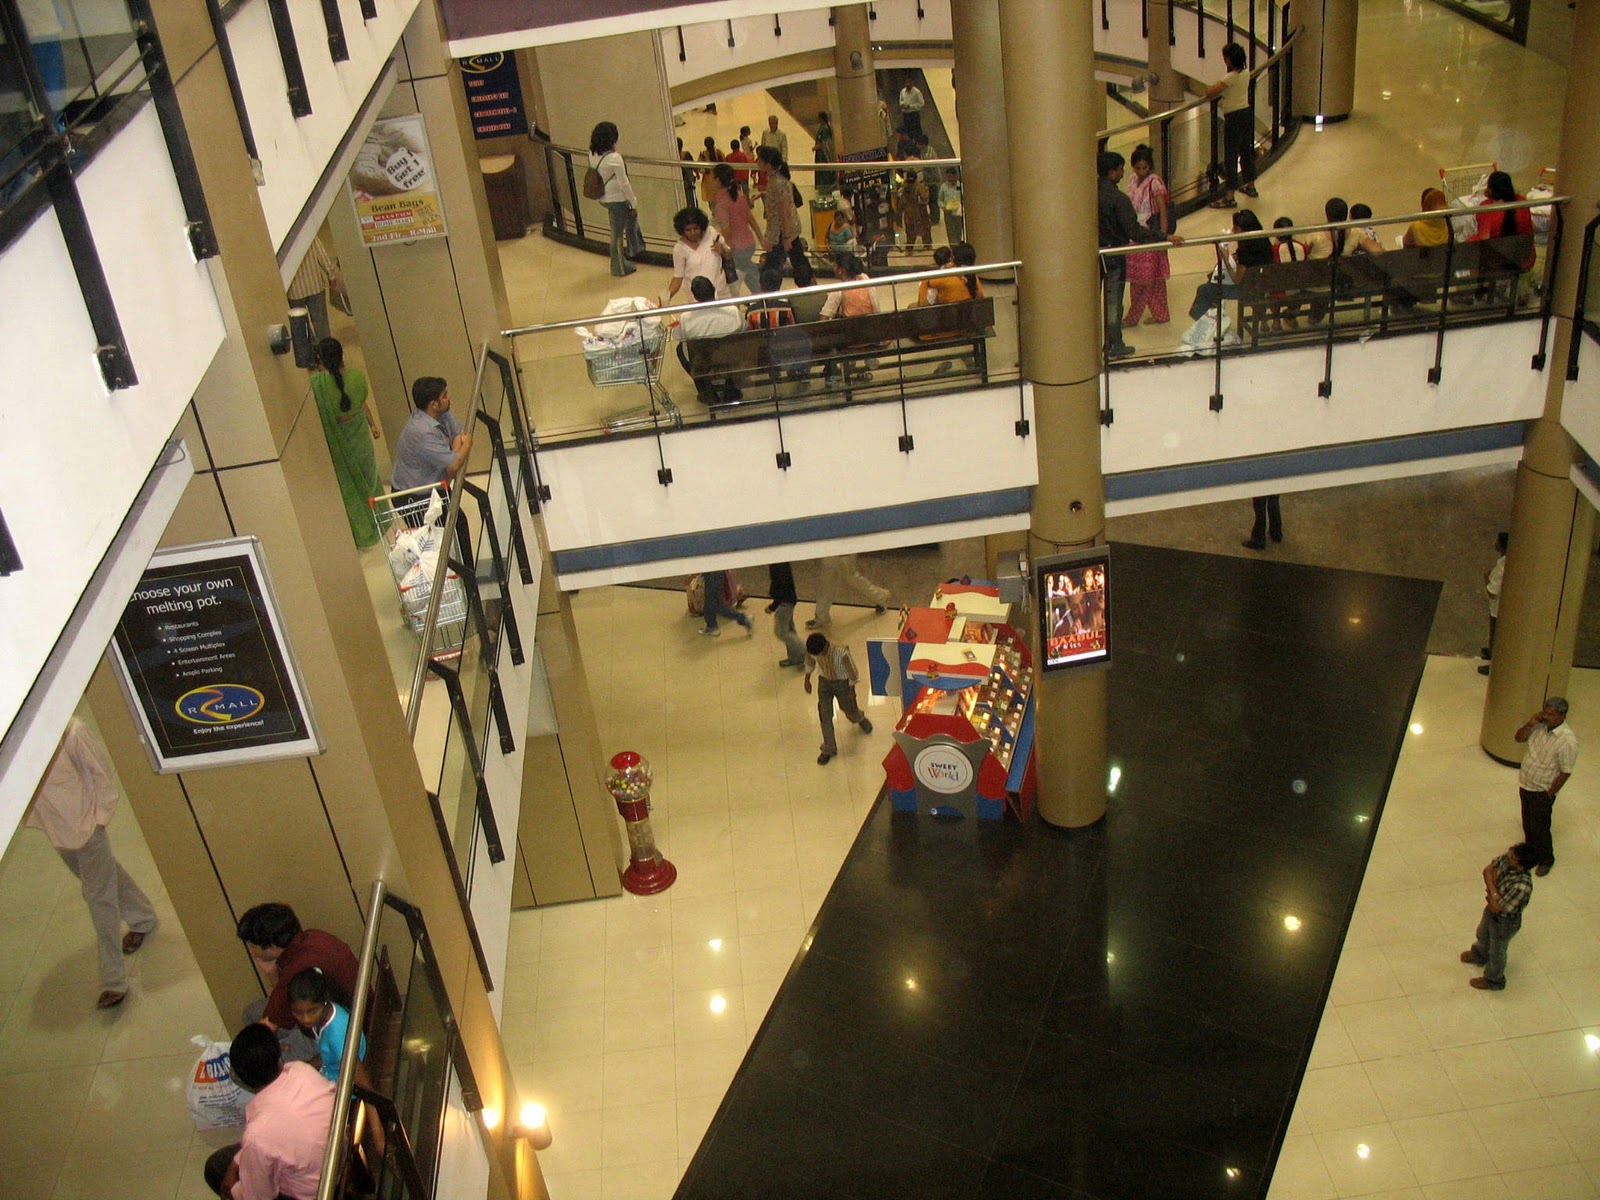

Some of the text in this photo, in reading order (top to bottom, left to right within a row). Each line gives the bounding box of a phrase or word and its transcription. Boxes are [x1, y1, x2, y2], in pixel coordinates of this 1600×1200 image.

[387, 149, 413, 175] Buy 1
[395, 166, 413, 182] Get
[372, 200, 424, 212] Bean Bags
[130, 577, 234, 602] hoose your own
[146, 594, 222, 615] melting pot.
[164, 621, 200, 630] Restaurants
[168, 629, 222, 643] Shopping Complex
[199, 641, 226, 651] Multiplex
[177, 652, 236, 666] Entertainment Areas
[200, 665, 224, 674] Parking
[187, 699, 258, 715] R MALL
[192, 719, 265, 736] Enjoy the experience!
[927, 767, 959, 781] World
